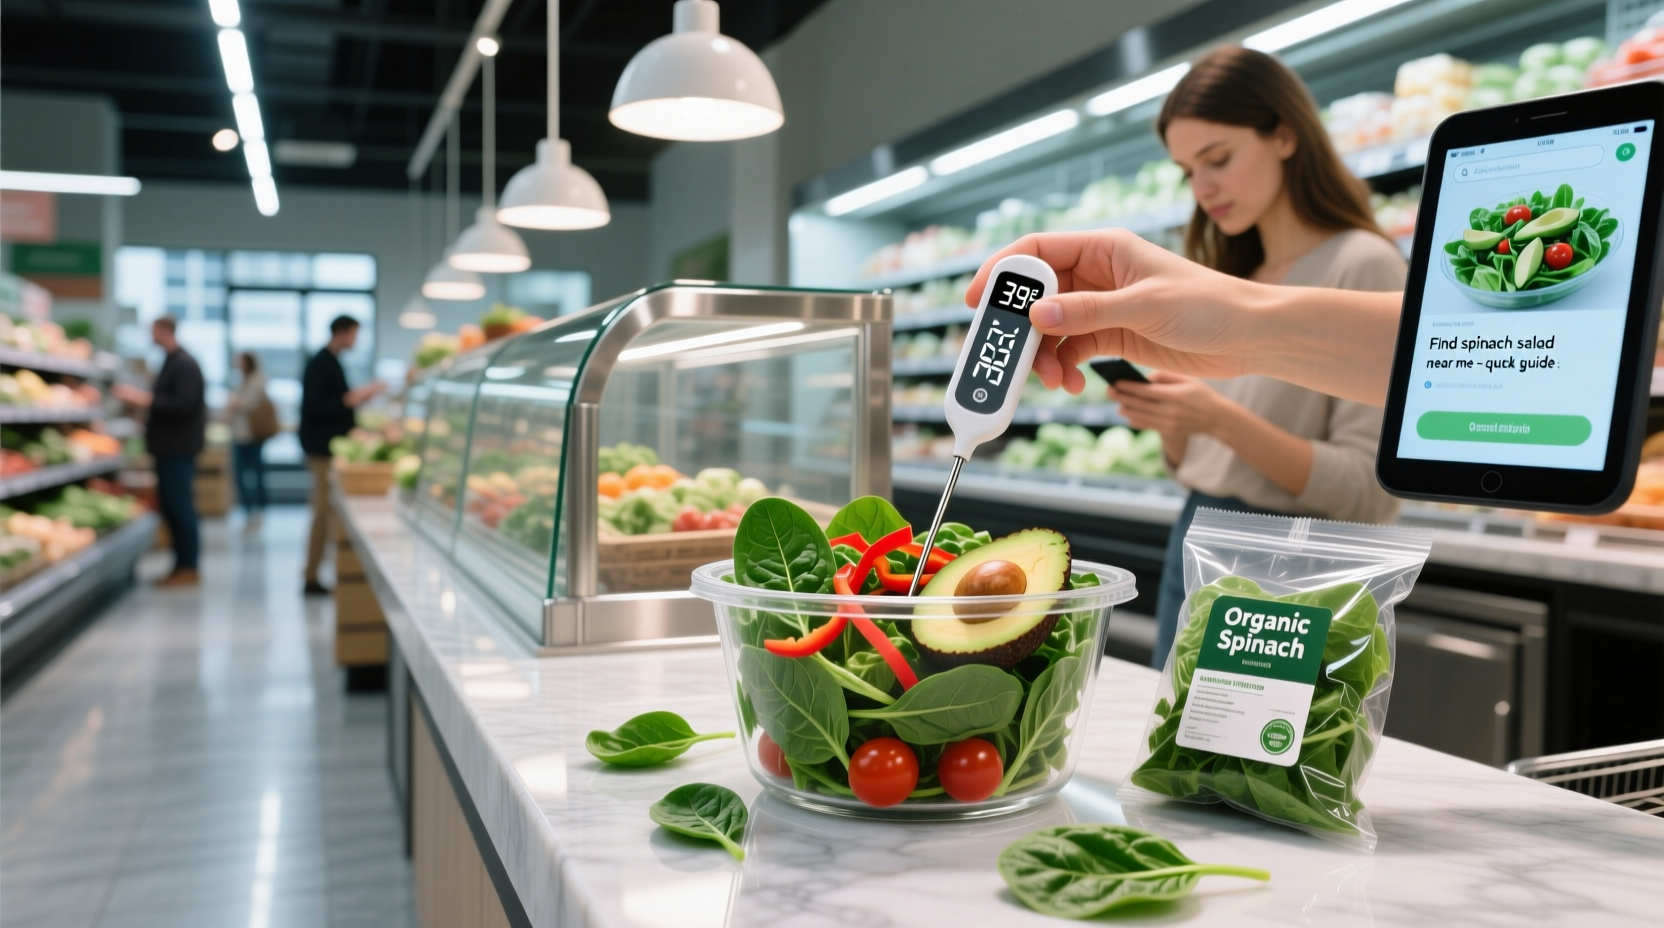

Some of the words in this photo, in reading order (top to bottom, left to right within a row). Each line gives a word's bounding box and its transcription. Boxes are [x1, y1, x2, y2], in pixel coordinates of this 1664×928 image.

[1460, 335, 1513, 353] spinach
[1426, 359, 1453, 369] near
[1455, 359, 1474, 369] me
[1224, 607, 1311, 635] Organic
[1217, 629, 1305, 659] Spinach
